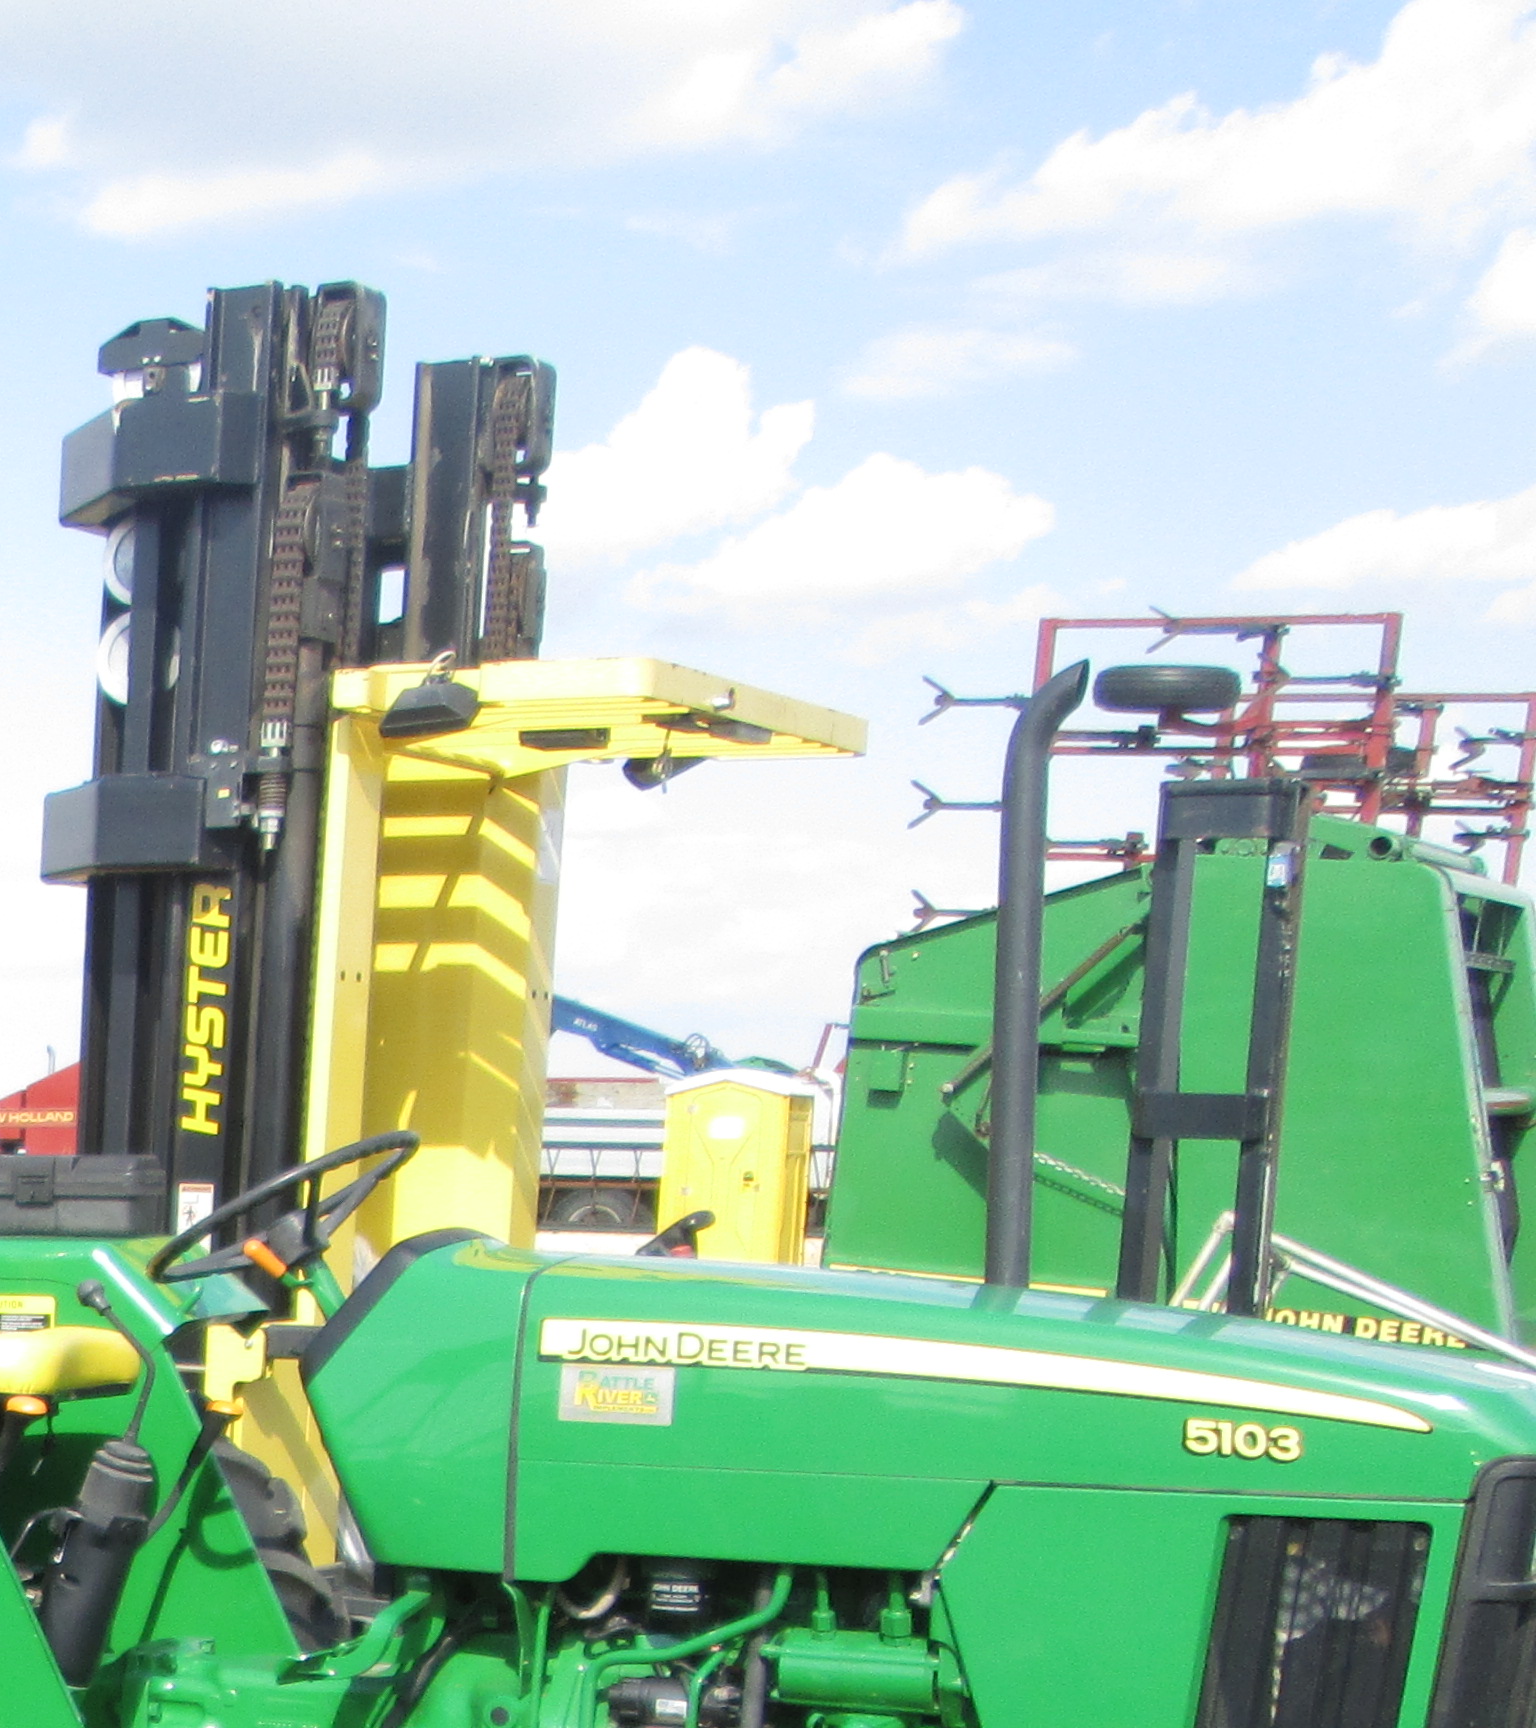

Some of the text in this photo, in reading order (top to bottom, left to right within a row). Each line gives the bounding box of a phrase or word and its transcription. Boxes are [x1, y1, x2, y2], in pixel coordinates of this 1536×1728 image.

[181, 882, 233, 1136] HYSTER
[8, 1110, 75, 1124] HOLLAND
[568, 1328, 808, 1366] JOHN DEERE
[574, 1382, 643, 1406] RIVER
[1183, 1417, 1303, 1462] 5103
